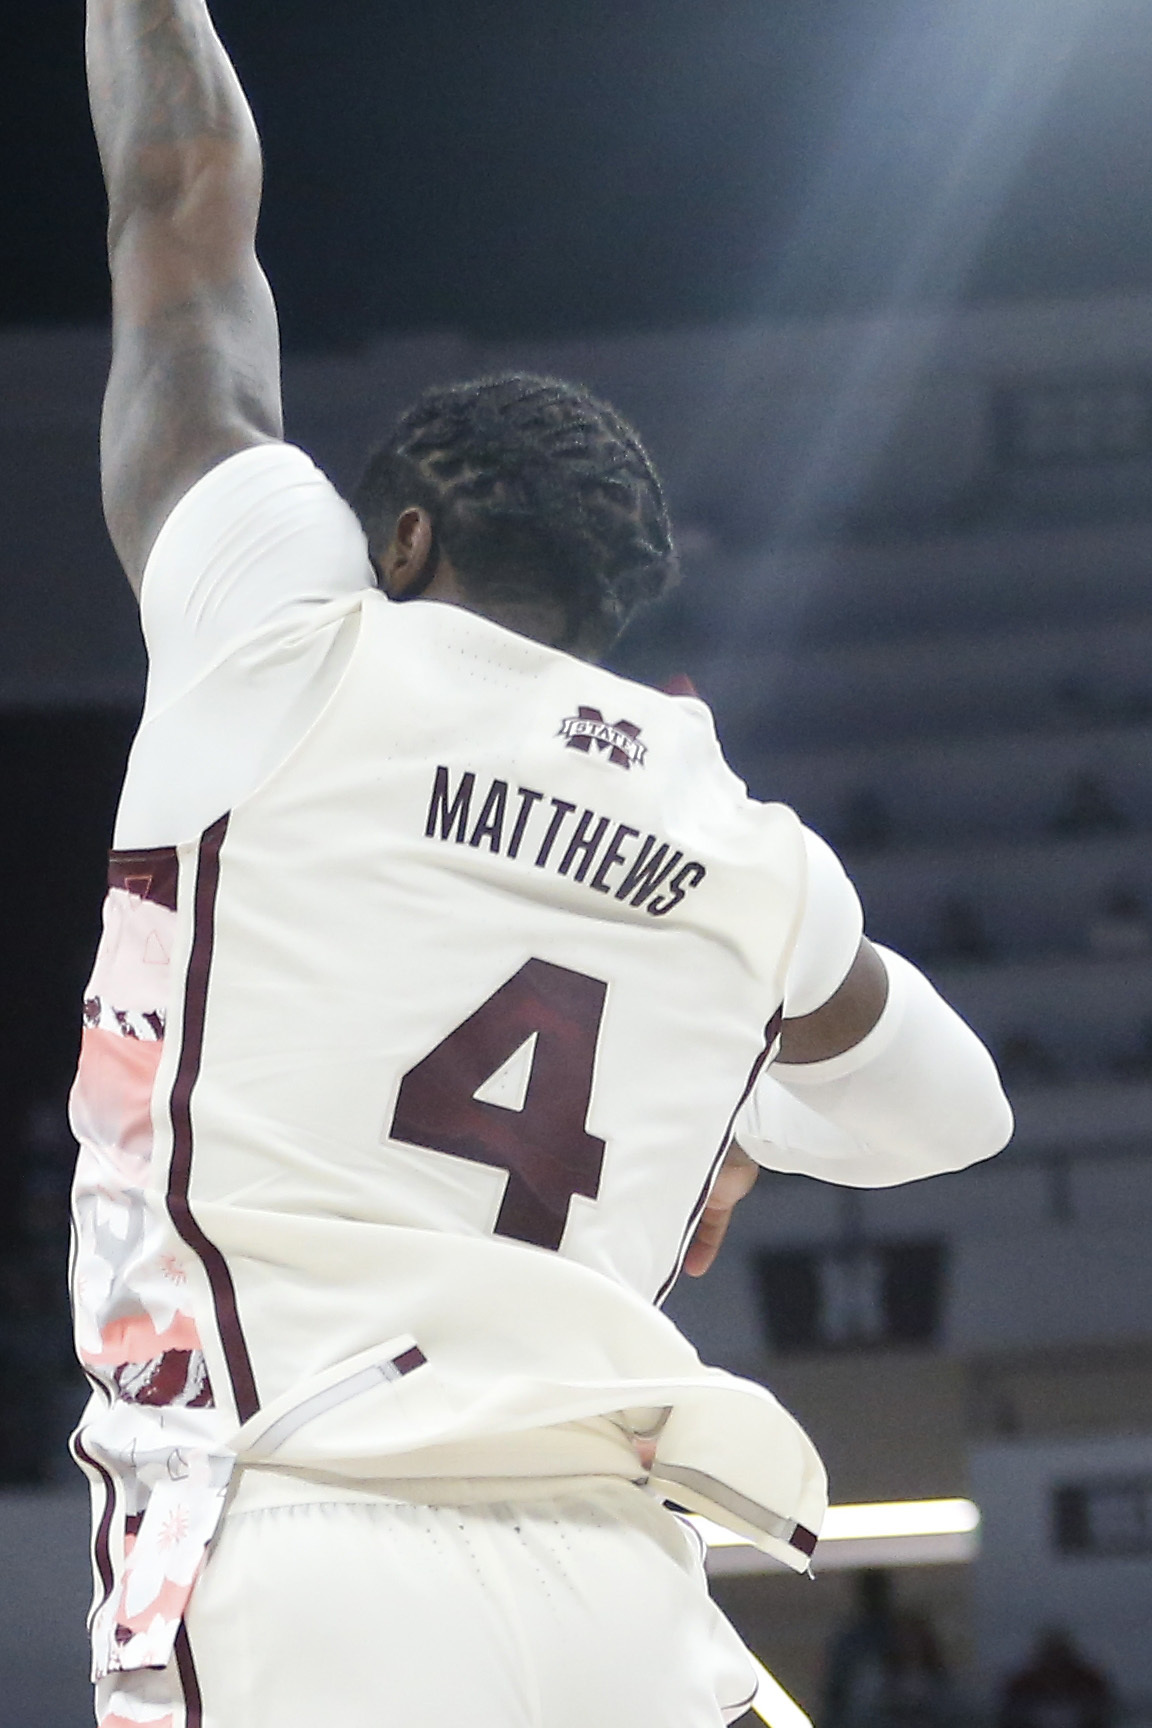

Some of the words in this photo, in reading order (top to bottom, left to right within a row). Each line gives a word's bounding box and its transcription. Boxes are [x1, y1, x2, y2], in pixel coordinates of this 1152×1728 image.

[575, 722, 634, 751] STATE
[425, 766, 707, 916] MATTHEWS
[389, 957, 608, 1251] 4
